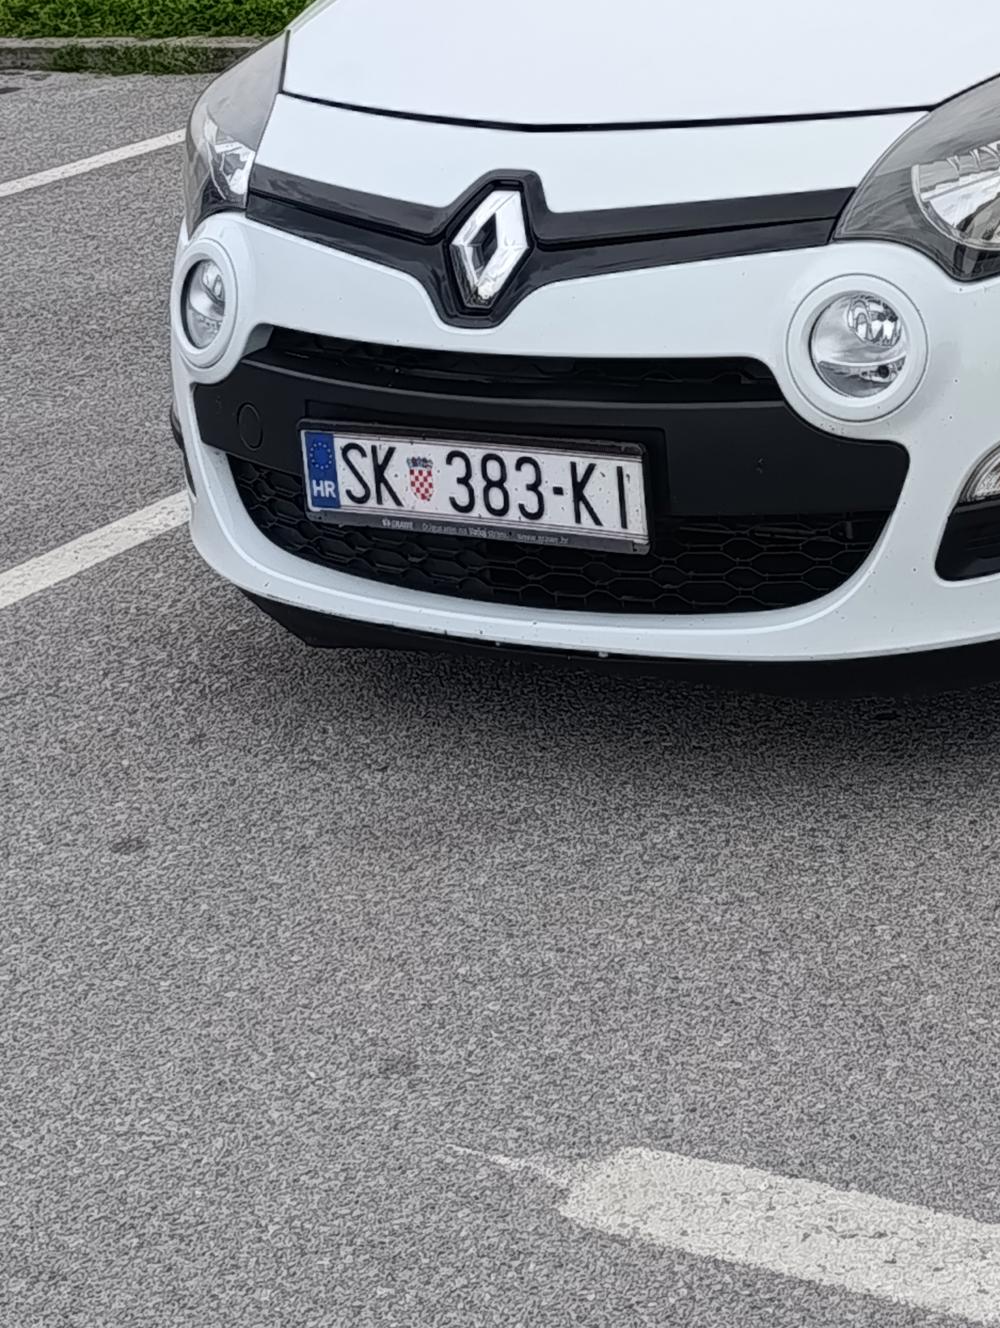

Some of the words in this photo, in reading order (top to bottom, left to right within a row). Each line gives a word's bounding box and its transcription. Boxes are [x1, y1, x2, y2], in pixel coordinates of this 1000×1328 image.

[312, 480, 336, 498] HR
[341, 442, 404, 507] SK
[446, 450, 628, 529] 383-KI
